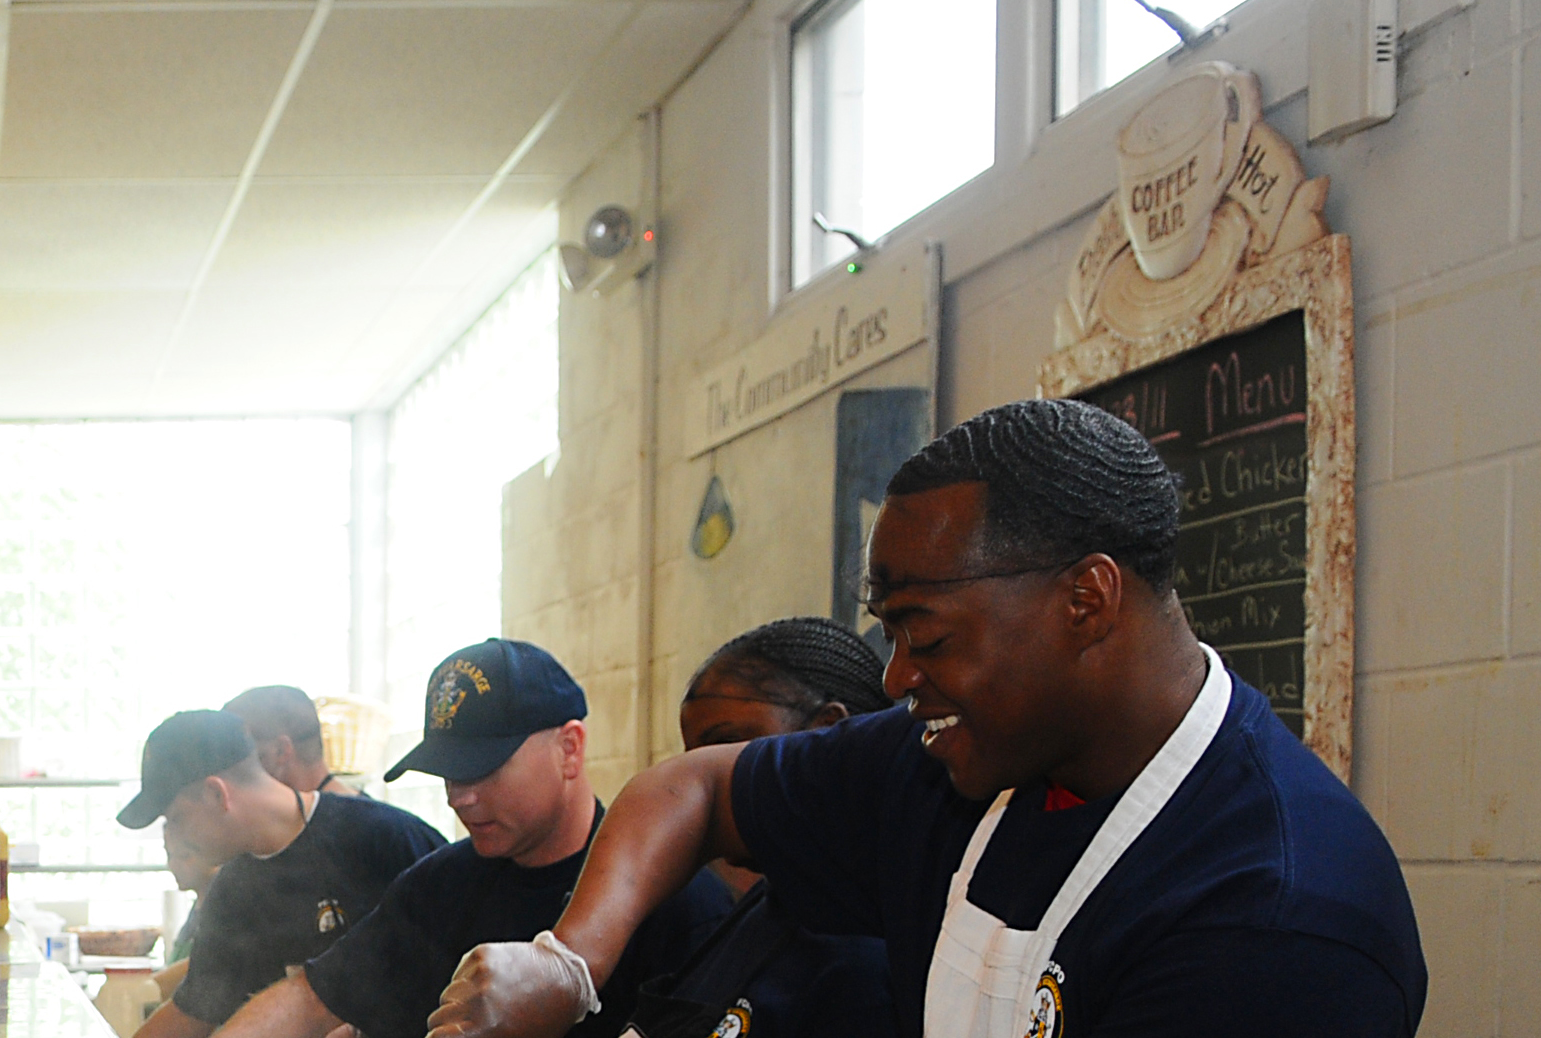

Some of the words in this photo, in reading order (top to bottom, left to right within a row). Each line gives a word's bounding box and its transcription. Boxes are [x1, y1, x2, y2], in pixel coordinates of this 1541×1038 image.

[1131, 155, 1198, 213] COFFEE
[1147, 202, 1186, 243] BAR
[833, 306, 889, 367] Cares
[1205, 352, 1295, 433] Menu
